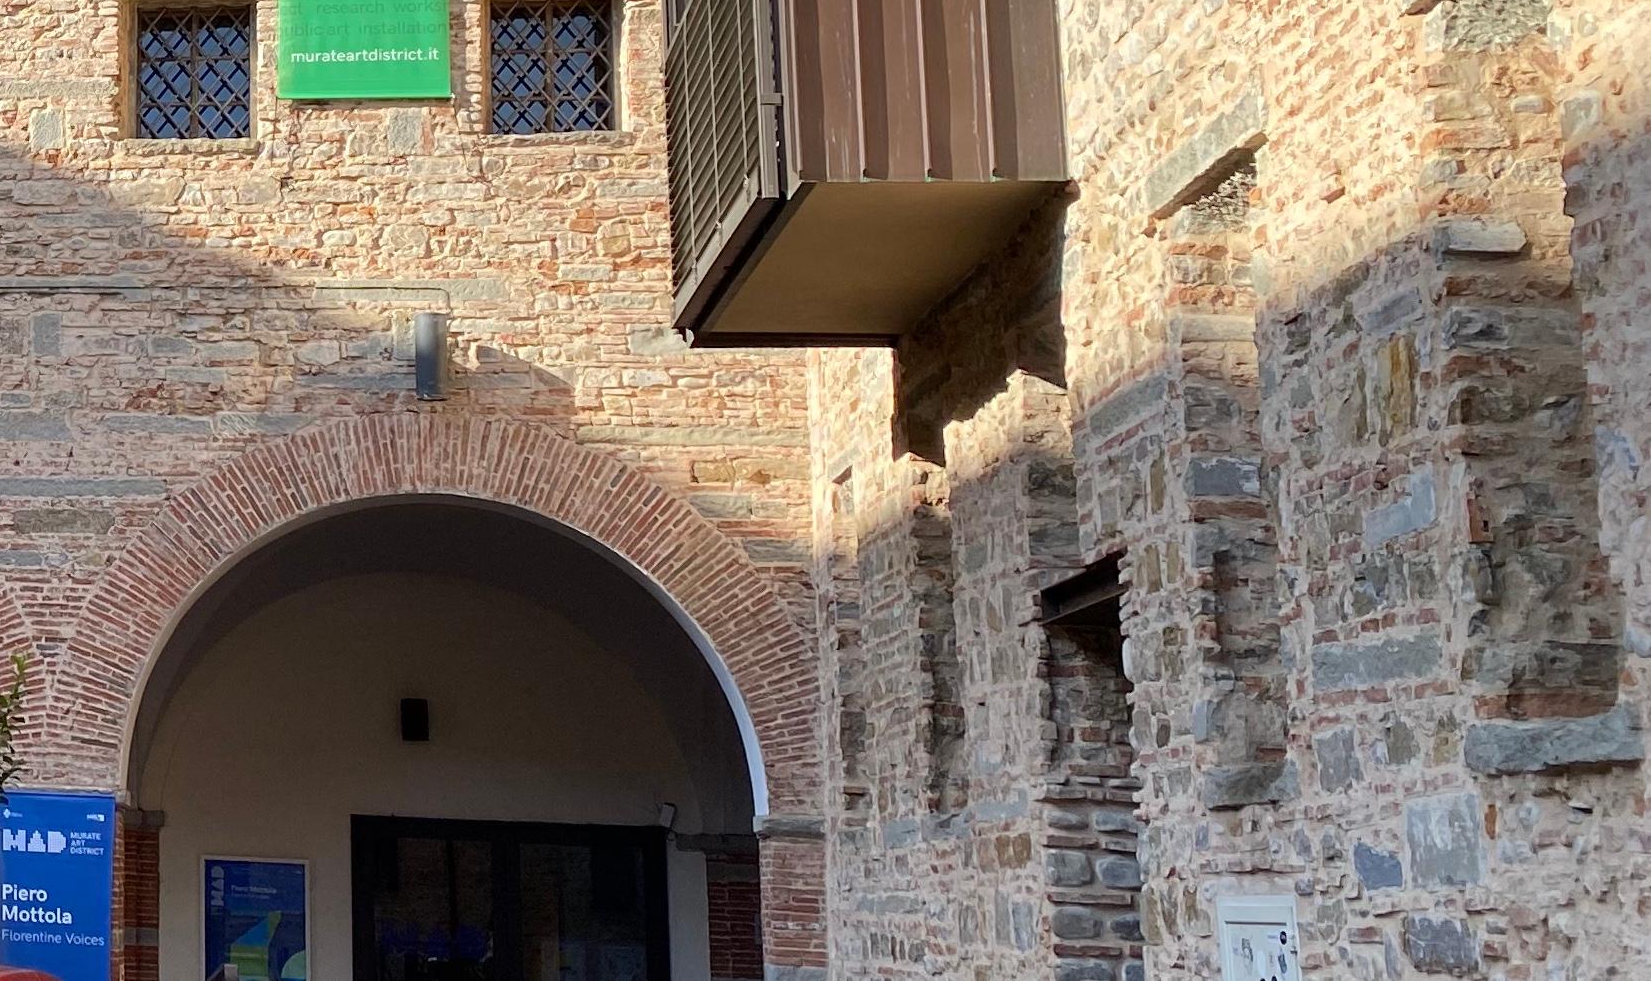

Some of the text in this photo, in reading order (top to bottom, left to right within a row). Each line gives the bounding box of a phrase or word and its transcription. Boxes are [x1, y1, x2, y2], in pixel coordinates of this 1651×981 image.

[291, 47, 439, 63] murateartdistrict.it
[2, 828, 67, 854] MAD
[70, 831, 102, 841] MURATE
[70, 847, 104, 856] DISTRICT
[2, 883, 47, 902] Piero
[2, 904, 72, 925] Mottola
[1, 928, 105, 947] Florentine Voices
